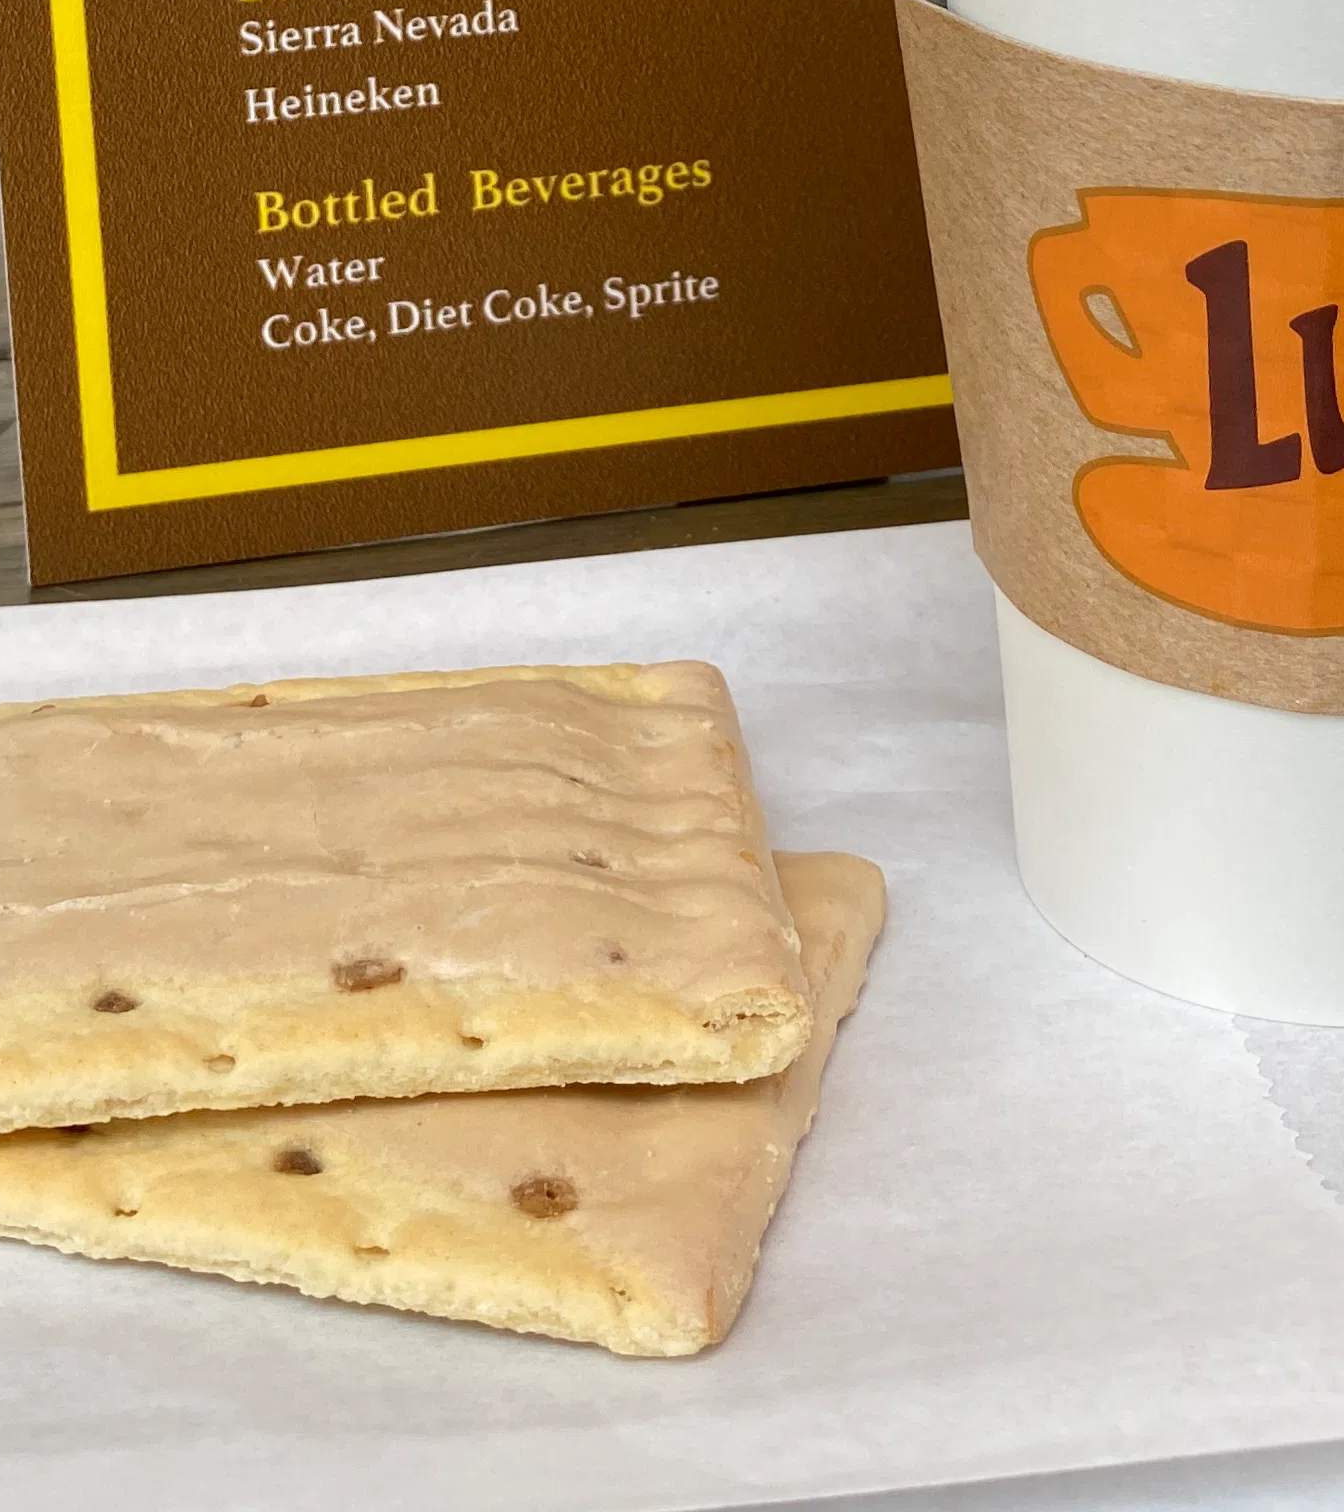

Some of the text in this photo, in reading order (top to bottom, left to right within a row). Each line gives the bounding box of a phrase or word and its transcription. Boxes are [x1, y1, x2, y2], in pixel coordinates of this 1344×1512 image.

[239, 0, 519, 56] Sierra Nevada
[244, 76, 441, 123] Heineken
[254, 159, 712, 234] Bottled Beverages
[257, 255, 385, 290] Water
[261, 270, 719, 349] Coke, Diet Coke, Sprite
